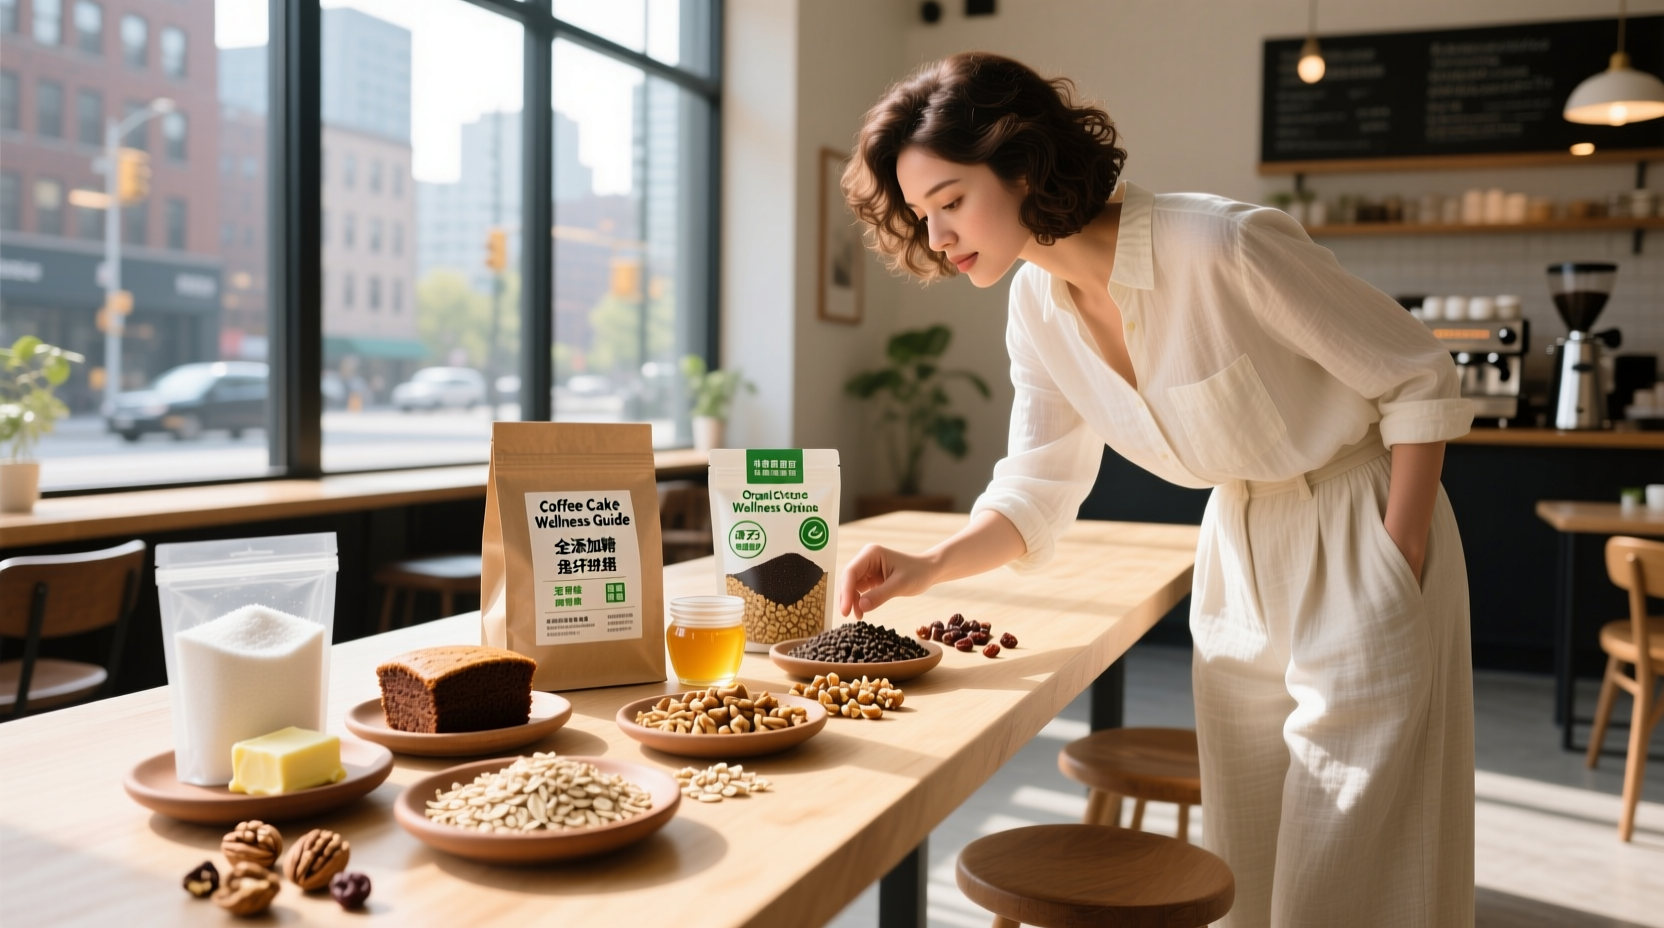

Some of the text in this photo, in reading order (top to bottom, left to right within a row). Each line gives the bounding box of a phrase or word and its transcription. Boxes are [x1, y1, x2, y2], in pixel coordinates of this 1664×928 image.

[539, 497, 620, 513] Coffee Cake
[535, 512, 630, 528] Wellness Guide
